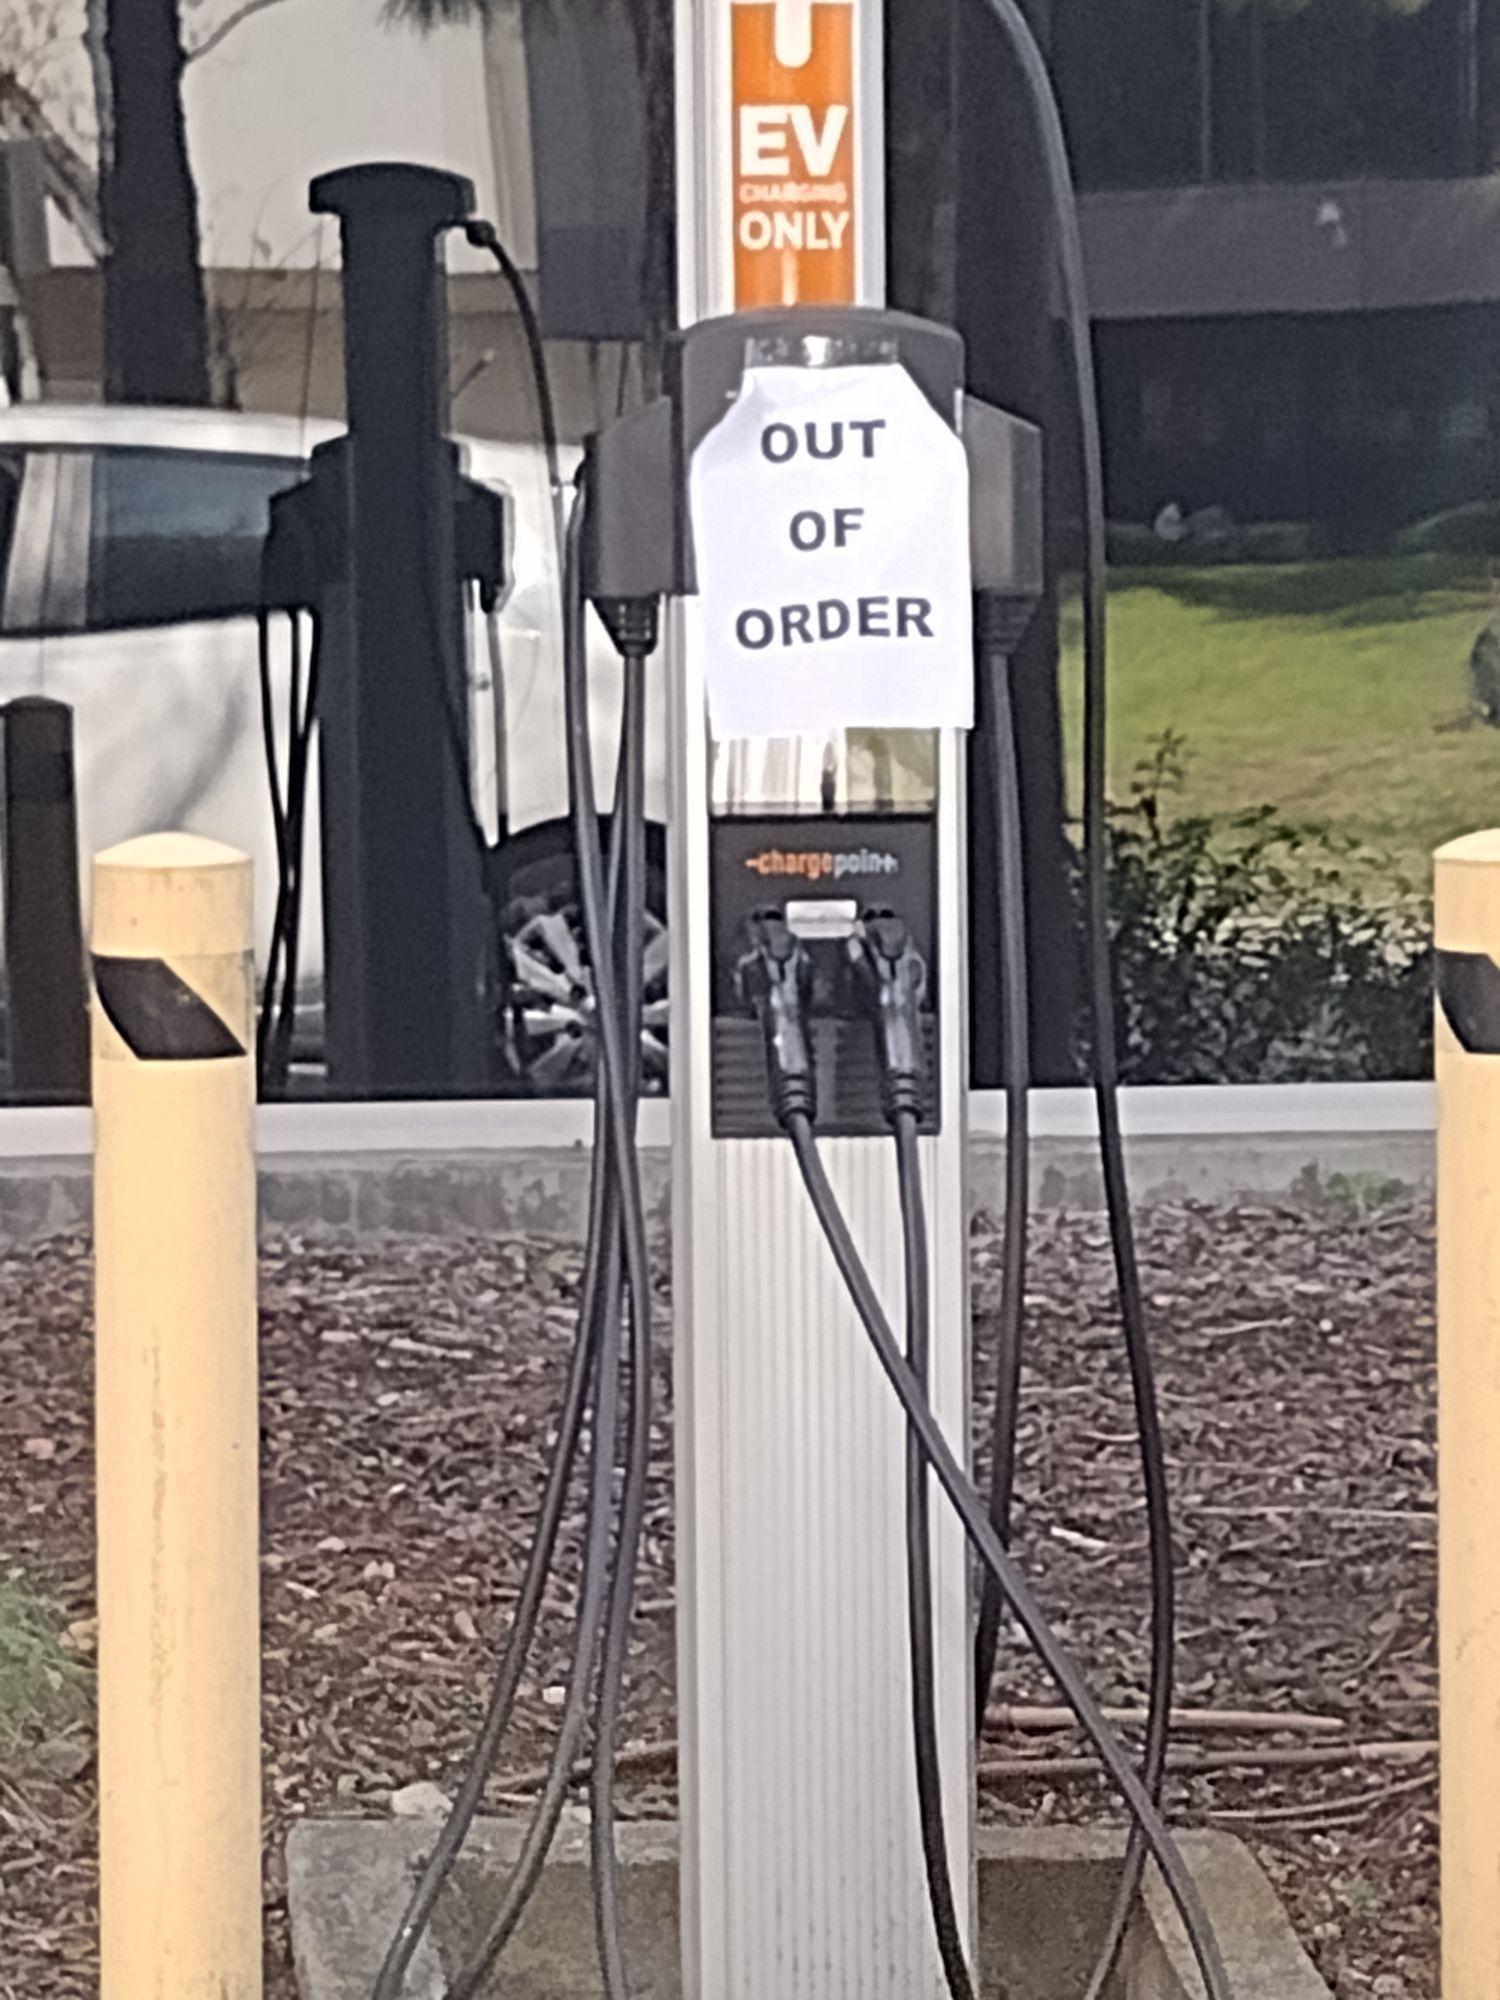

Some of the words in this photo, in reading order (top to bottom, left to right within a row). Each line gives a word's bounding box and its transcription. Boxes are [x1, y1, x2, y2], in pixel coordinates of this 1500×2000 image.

[739, 104, 849, 176] EV
[739, 210, 850, 250] ONLY
[760, 419, 886, 463] OUT
[789, 508, 865, 552] OF
[735, 596, 934, 650] ORDER
